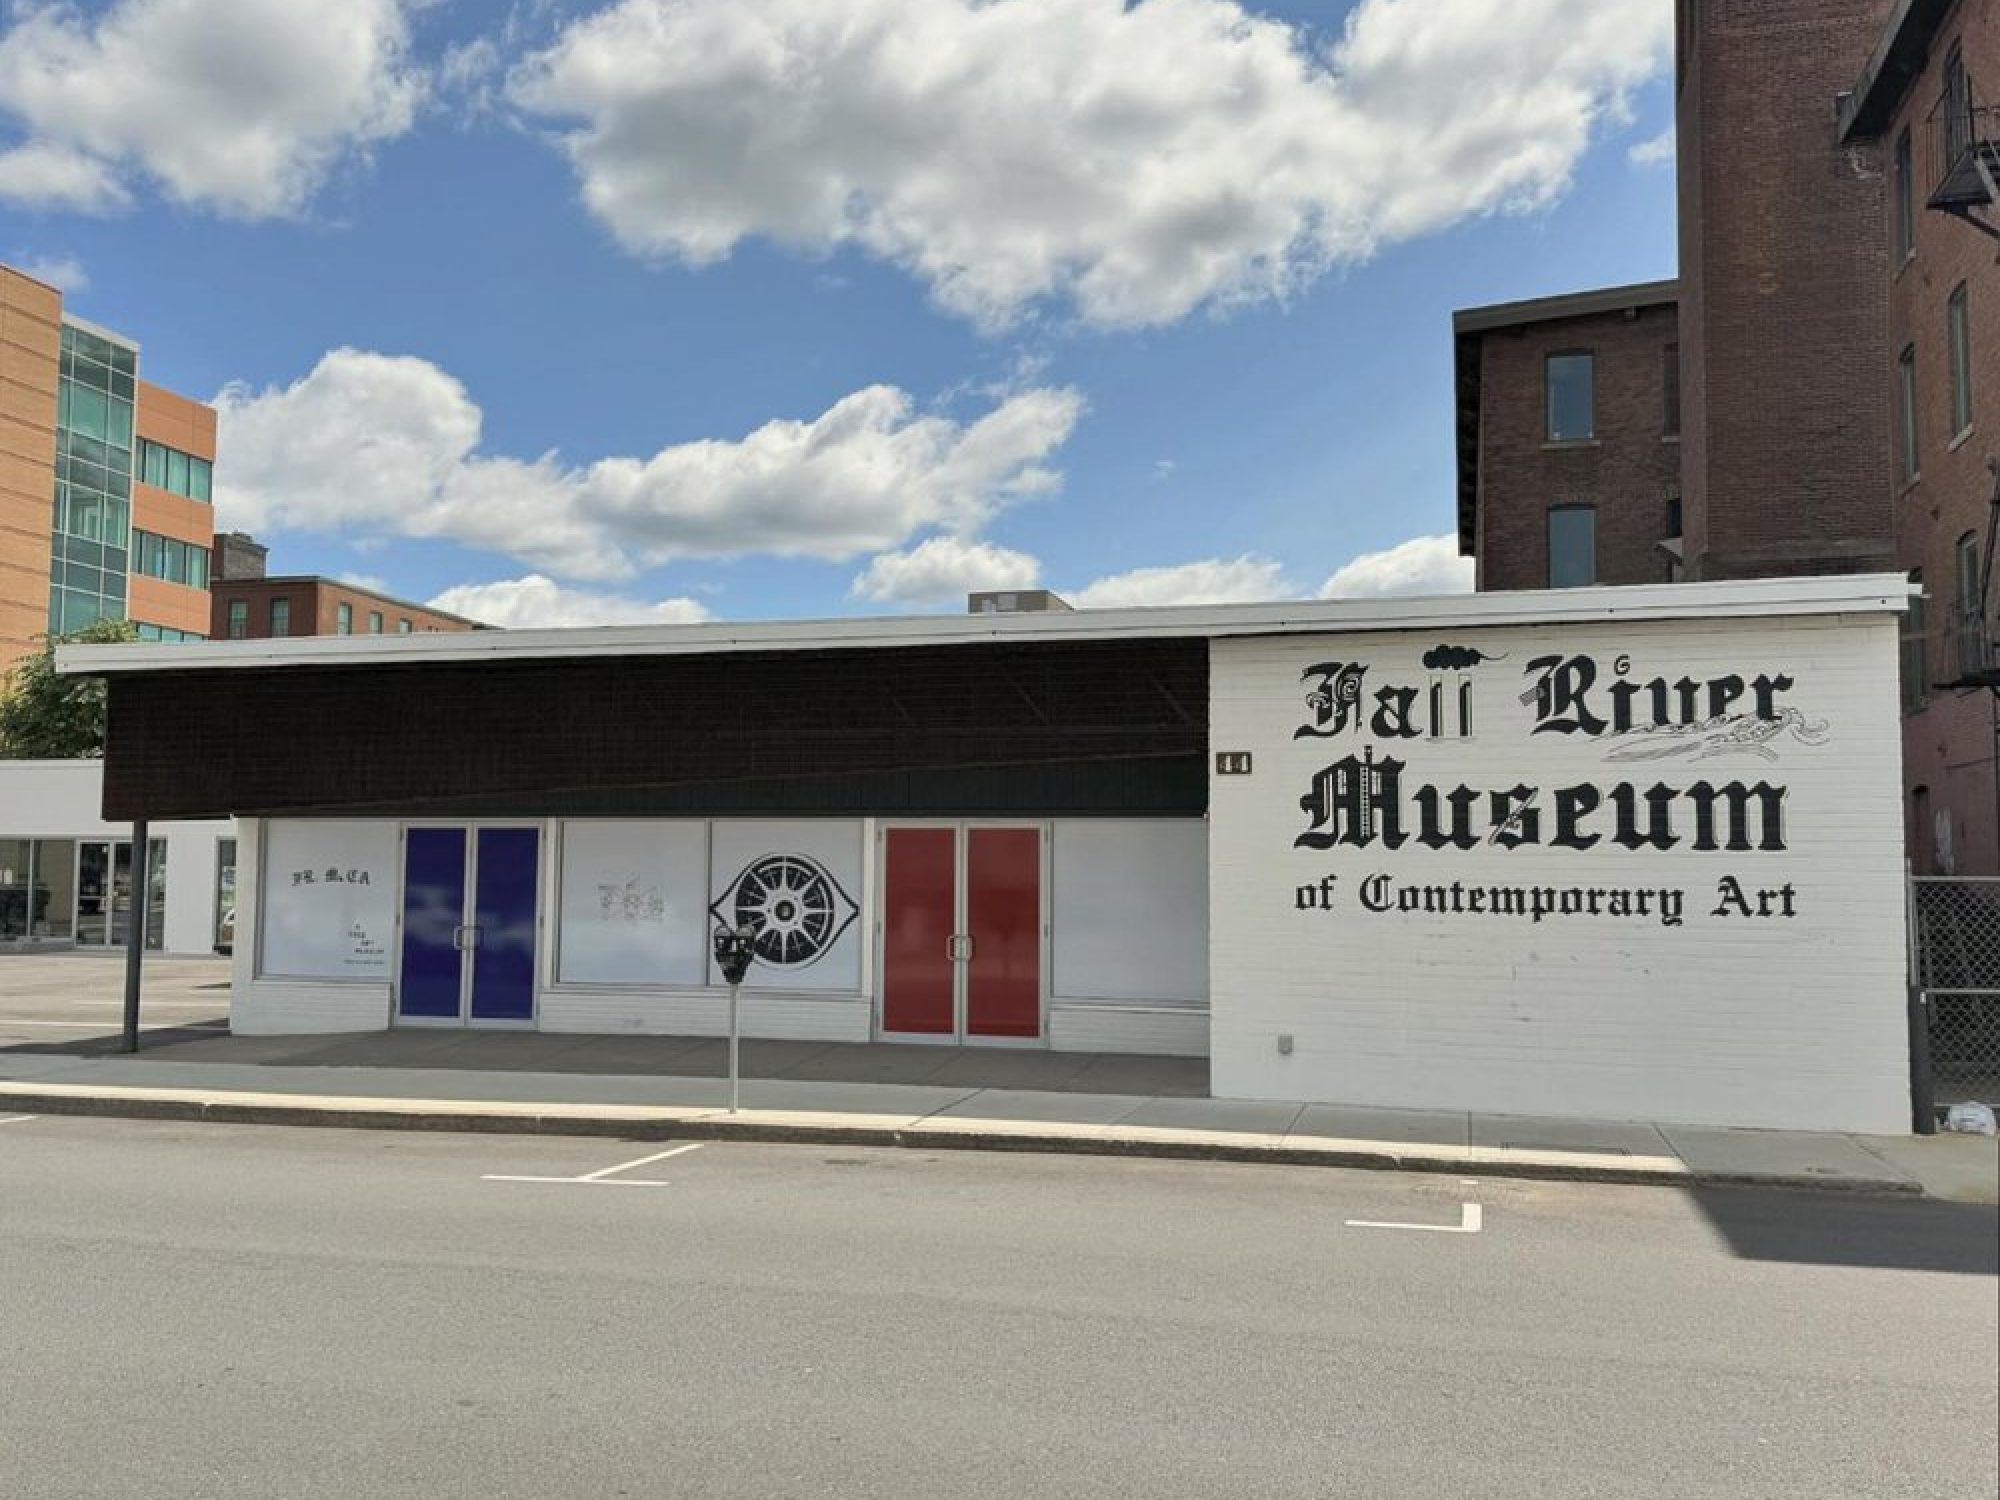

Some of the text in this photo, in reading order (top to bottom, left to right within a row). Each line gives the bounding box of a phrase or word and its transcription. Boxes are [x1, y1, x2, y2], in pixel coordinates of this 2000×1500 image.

[1294, 650, 1794, 739] Fall River
[1294, 745, 1787, 850] Museum
[1295, 873, 1797, 926] of Contemporary Art
